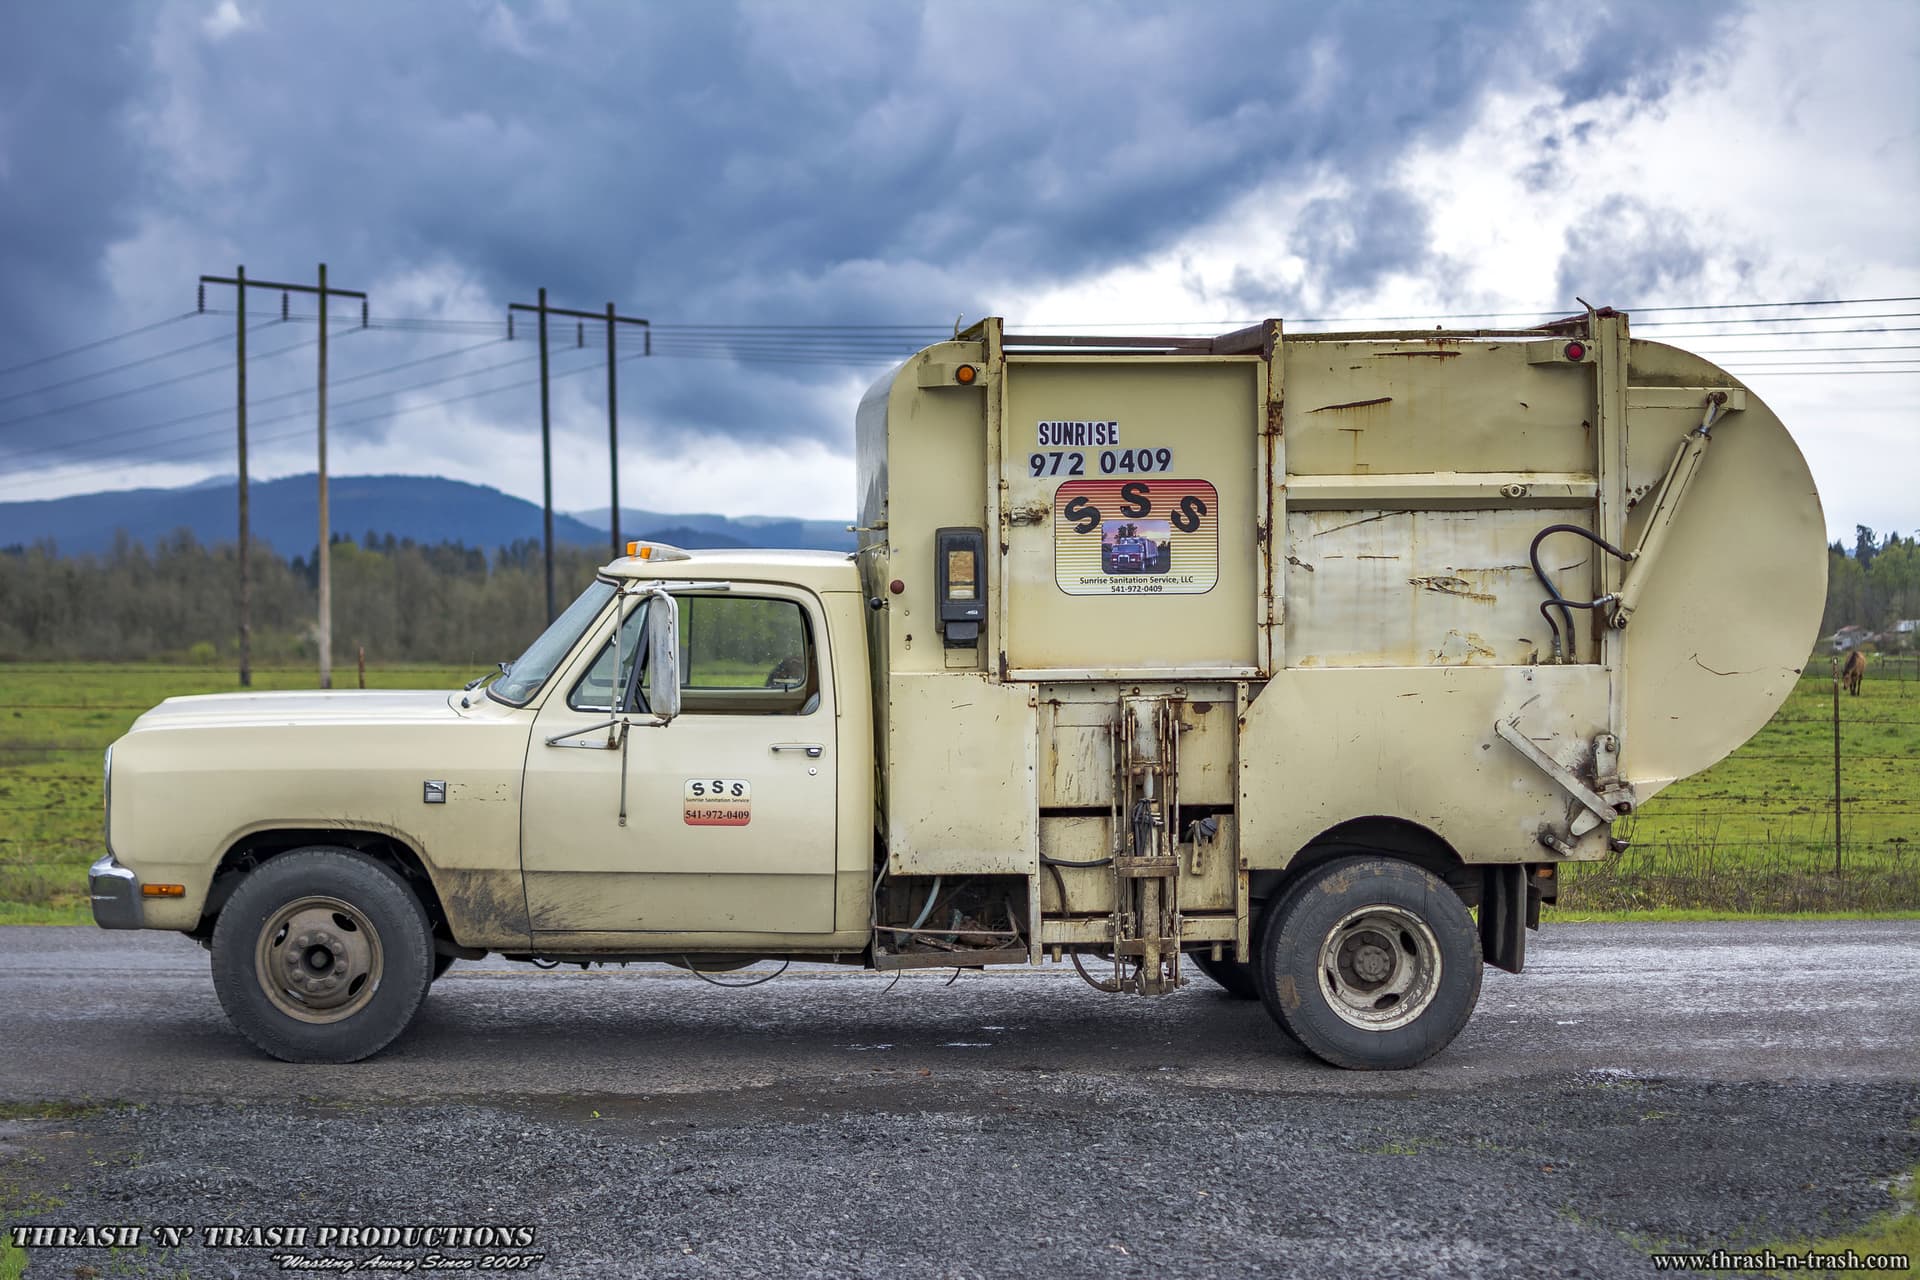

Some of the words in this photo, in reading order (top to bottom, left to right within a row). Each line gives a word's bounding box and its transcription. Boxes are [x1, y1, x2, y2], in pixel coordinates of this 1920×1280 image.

[1039, 421, 1118, 446] SUNRISE
[1030, 452, 1084, 477] 972
[1100, 448, 1171, 474] 0409
[1064, 496, 1101, 534] S
[1120, 482, 1152, 518] S
[1170, 495, 1208, 533] S
[1080, 576, 1107, 585] Sunrise
[1109, 575, 1148, 584] Sanitation
[1149, 575, 1179, 584] Service,
[1180, 575, 1193, 583] LLC
[1111, 585, 1163, 593] 541-972-0409
[692, 782, 704, 796] S
[712, 780, 724, 794] S
[731, 783, 743, 796] S
[686, 810, 749, 819] 541-972-0409
